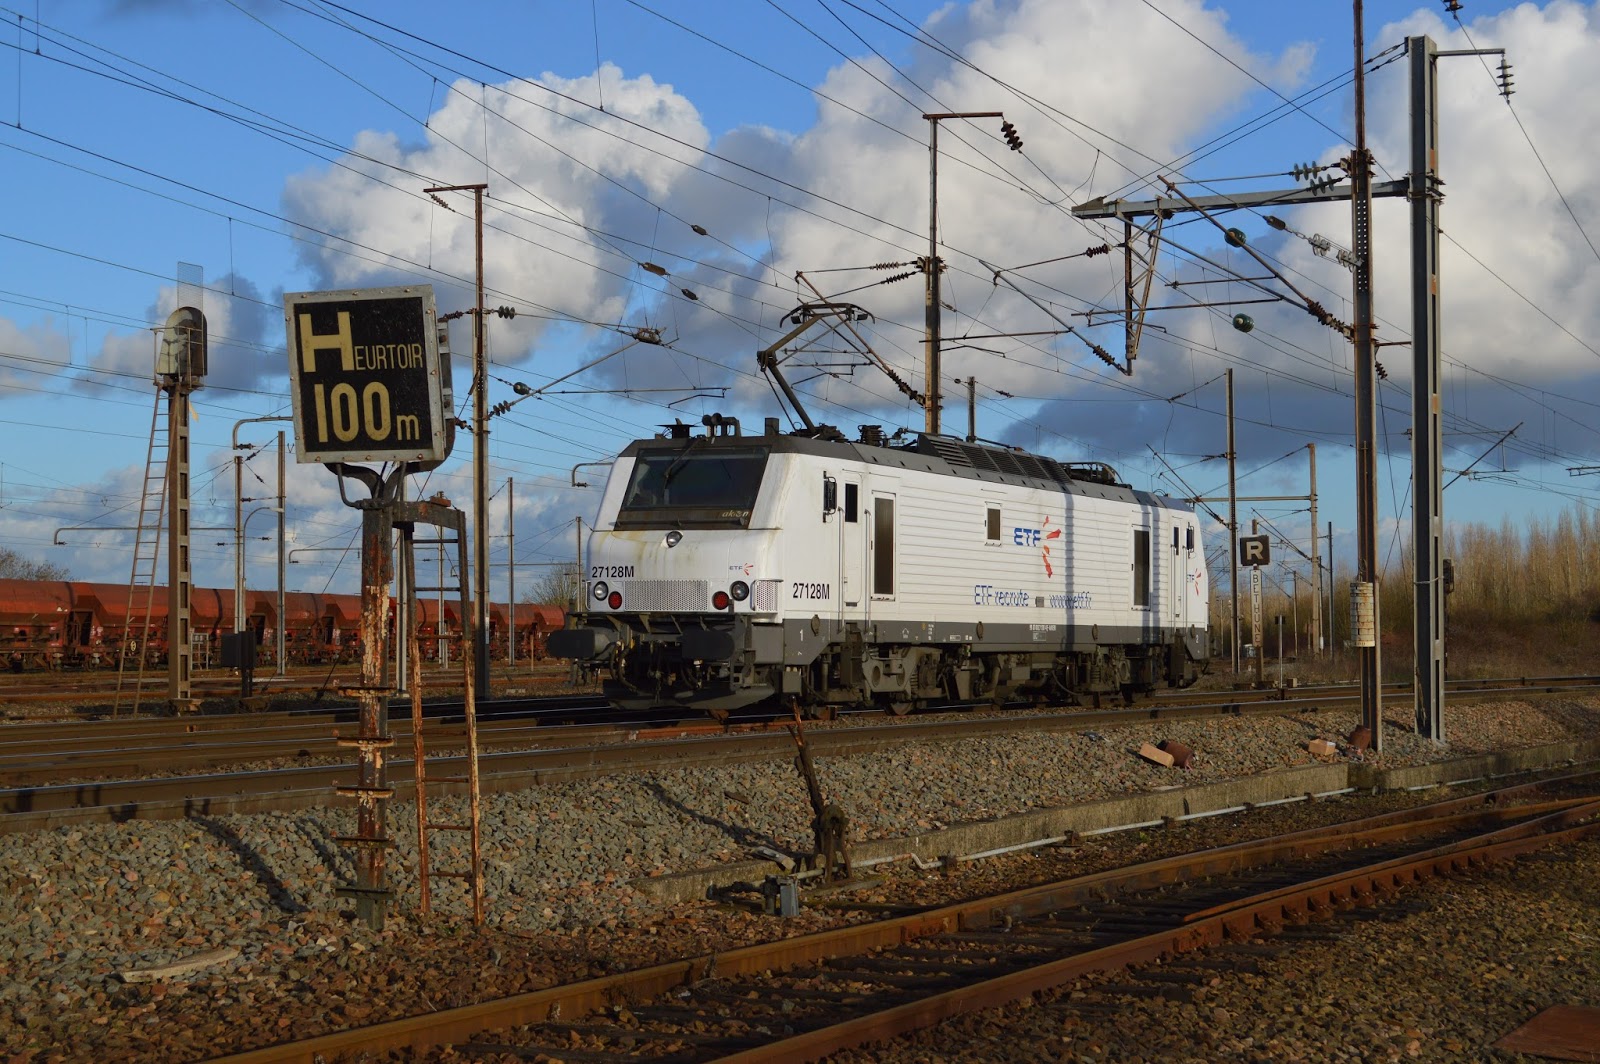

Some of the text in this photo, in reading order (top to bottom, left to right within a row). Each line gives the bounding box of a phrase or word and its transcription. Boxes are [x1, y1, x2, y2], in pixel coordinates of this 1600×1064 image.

[299, 311, 423, 373] HEURTOIR
[314, 381, 420, 442] 100 m
[1013, 527, 1041, 547] ETF
[1246, 541, 1264, 560] R
[592, 566, 634, 578] 27128M
[793, 582, 830, 600] 27128M
[975, 585, 993, 605] ETF
[994, 589, 1029, 607] recrute
[1252, 574, 1261, 642] BETHUNE
